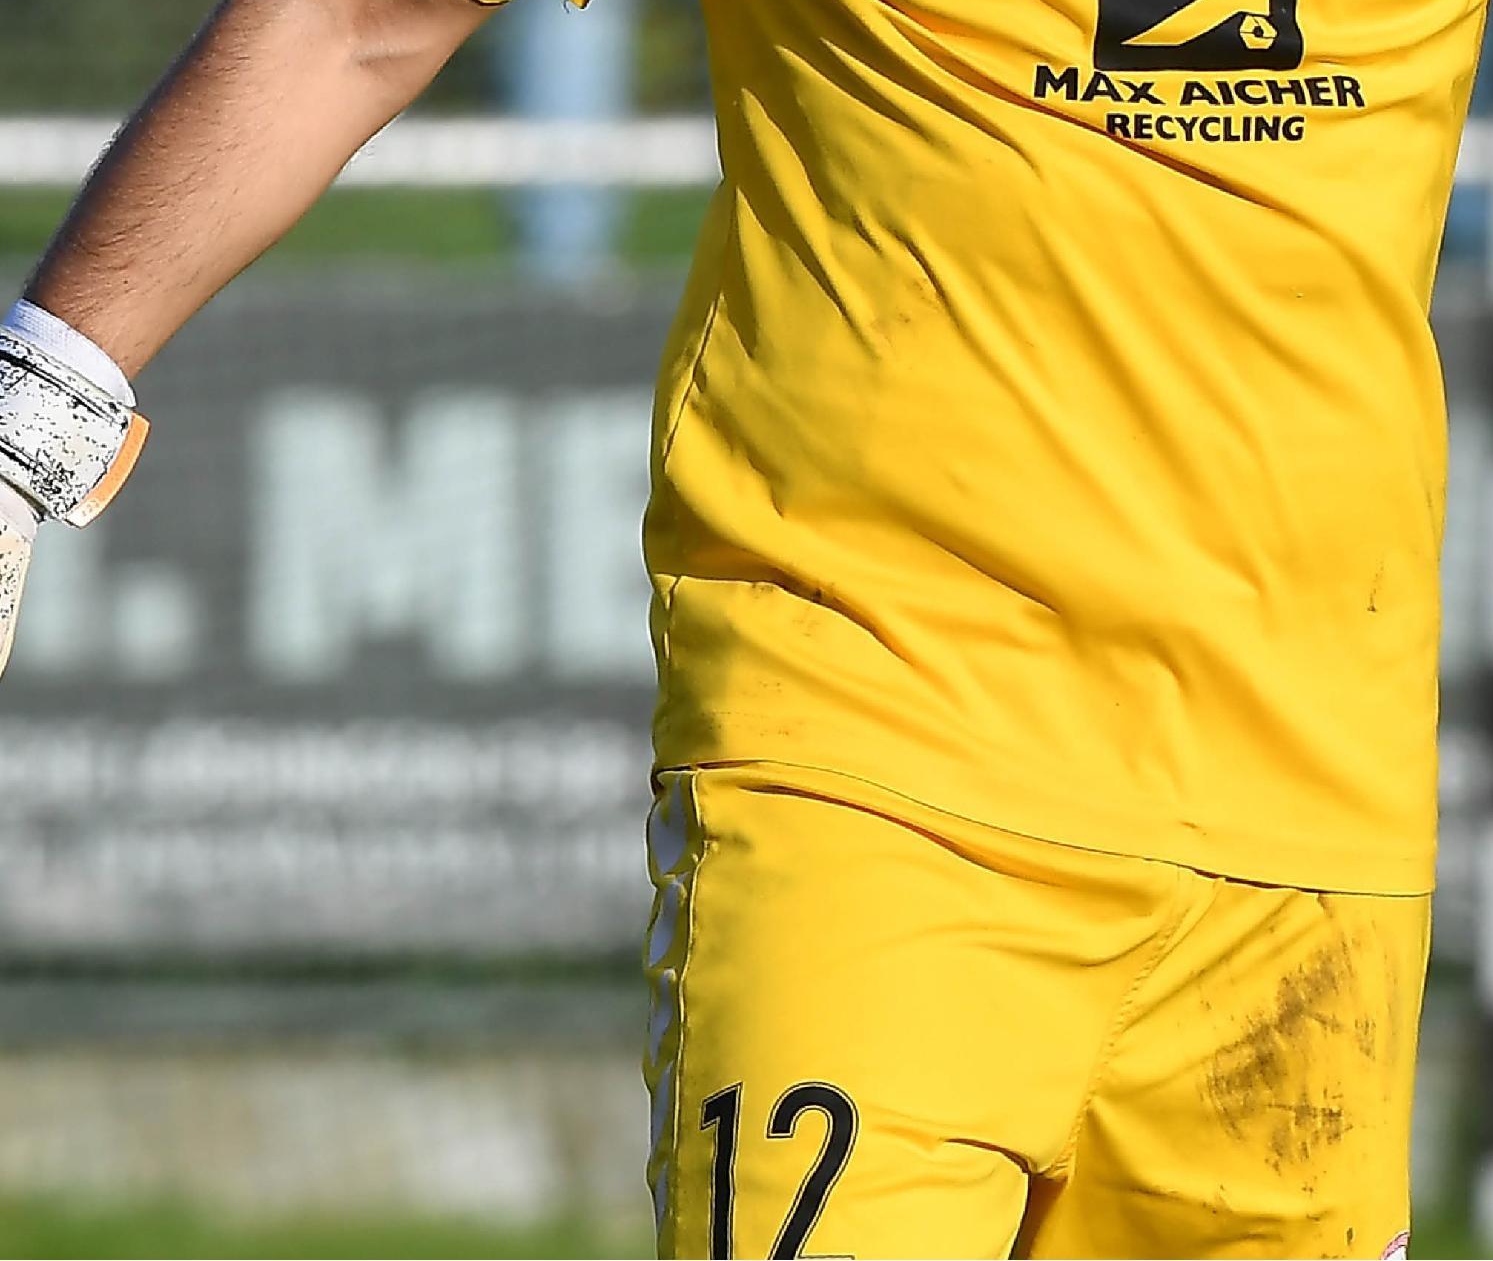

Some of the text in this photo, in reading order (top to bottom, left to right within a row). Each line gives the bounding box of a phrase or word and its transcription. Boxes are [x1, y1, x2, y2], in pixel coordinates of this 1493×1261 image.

[1033, 65, 1365, 108] MAX AICHER
[1106, 113, 1305, 142] RECYCLING
[700, 1081, 860, 1260] 12
